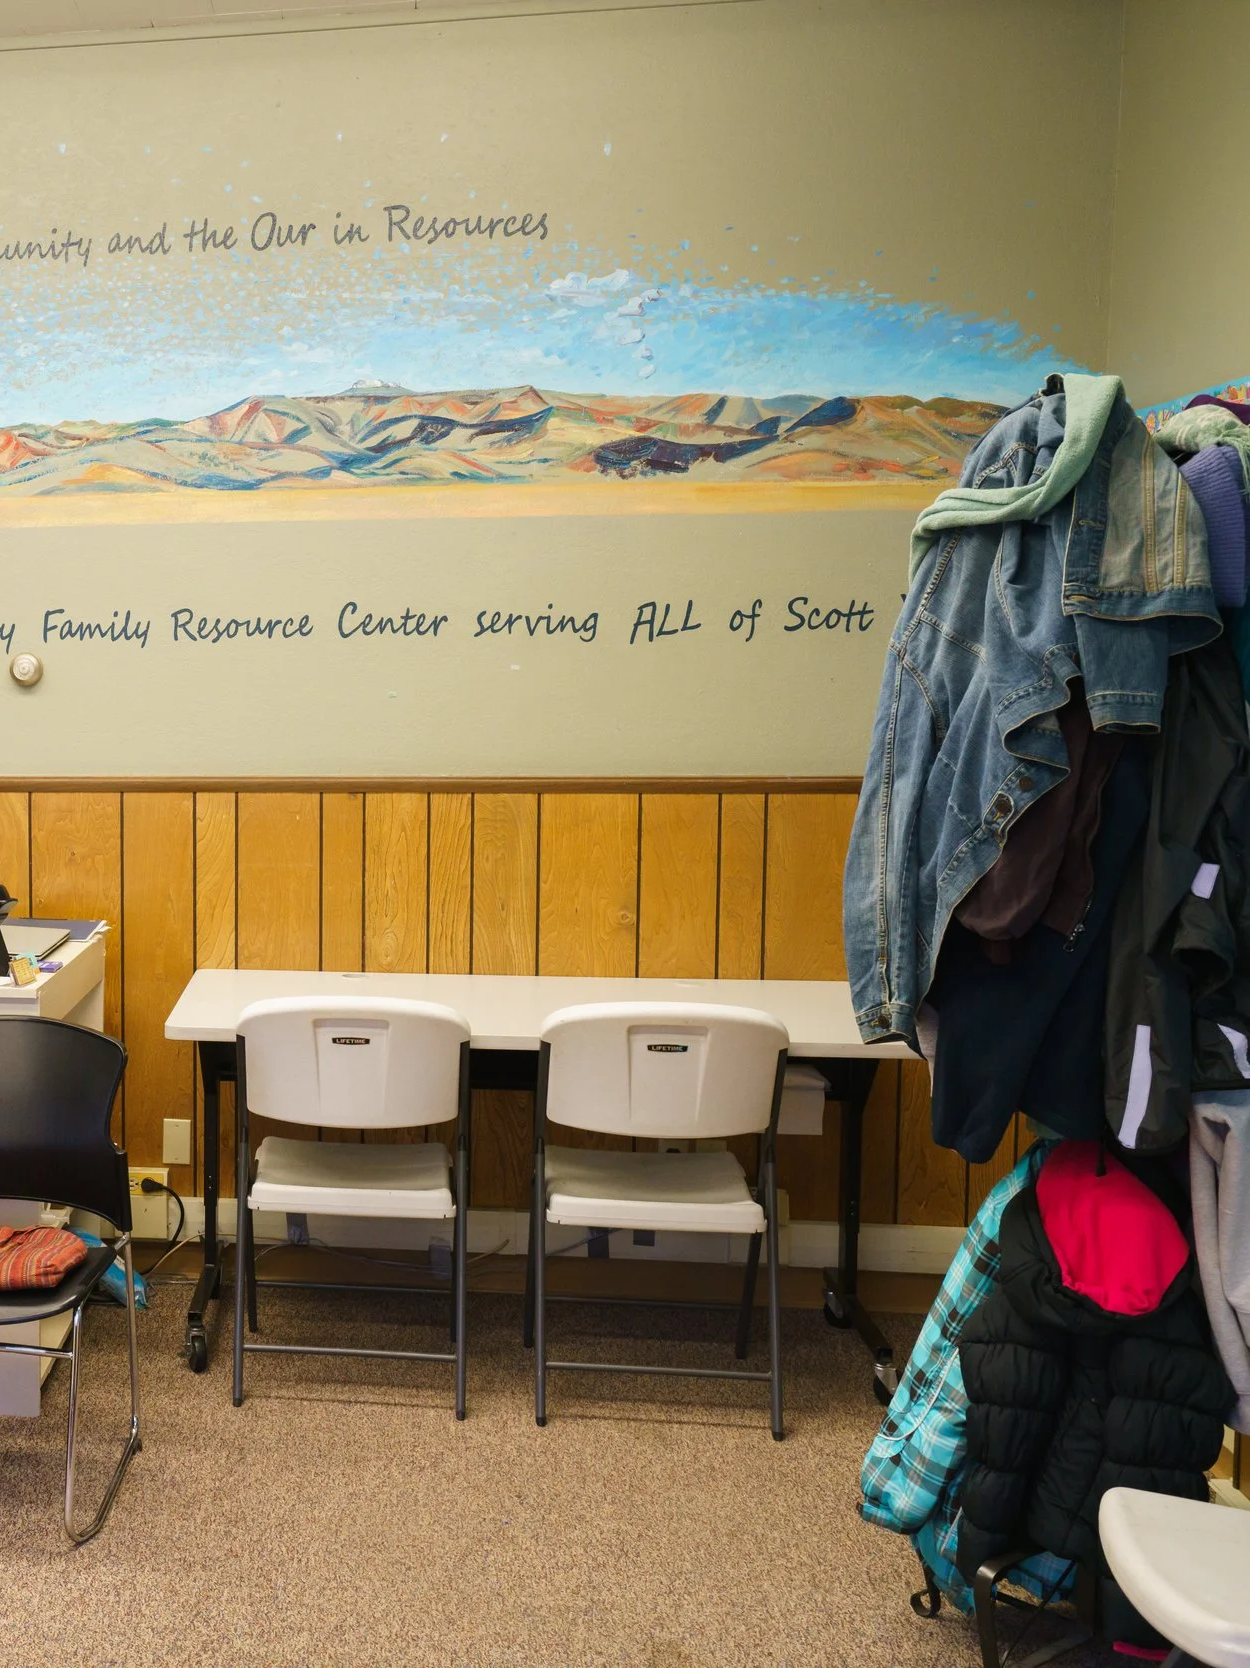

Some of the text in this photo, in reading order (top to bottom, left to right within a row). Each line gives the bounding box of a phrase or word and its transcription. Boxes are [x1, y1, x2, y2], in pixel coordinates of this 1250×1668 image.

[107, 221, 171, 256] and
[183, 217, 237, 252] the
[250, 211, 317, 252] Our
[333, 212, 370, 245] in
[384, 203, 550, 245] Resources
[42, 607, 152, 649] Family
[171, 607, 314, 643] Resource
[338, 601, 449, 640] Center
[473, 603, 598, 643] serving
[629, 600, 701, 645] ALL
[729, 599, 763, 643] of
[783, 596, 874, 633] Scott
